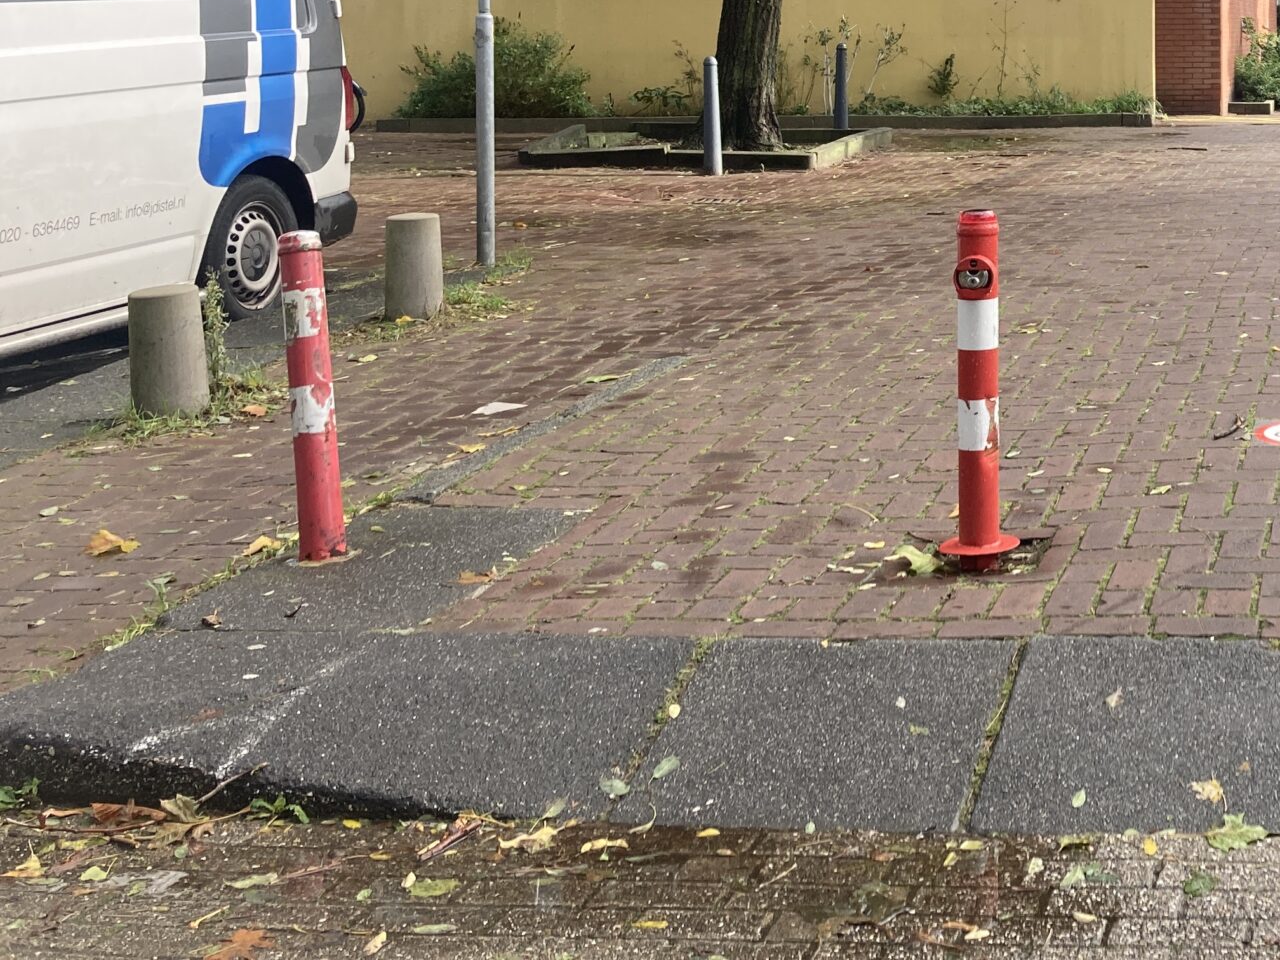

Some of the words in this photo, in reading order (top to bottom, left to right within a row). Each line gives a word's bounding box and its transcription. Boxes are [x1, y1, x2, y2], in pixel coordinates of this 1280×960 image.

[32, 215, 81, 238] 6364469
[89, 208, 122, 227] E-mail:
[125, 195, 186, 219] info@jdistel.nl
